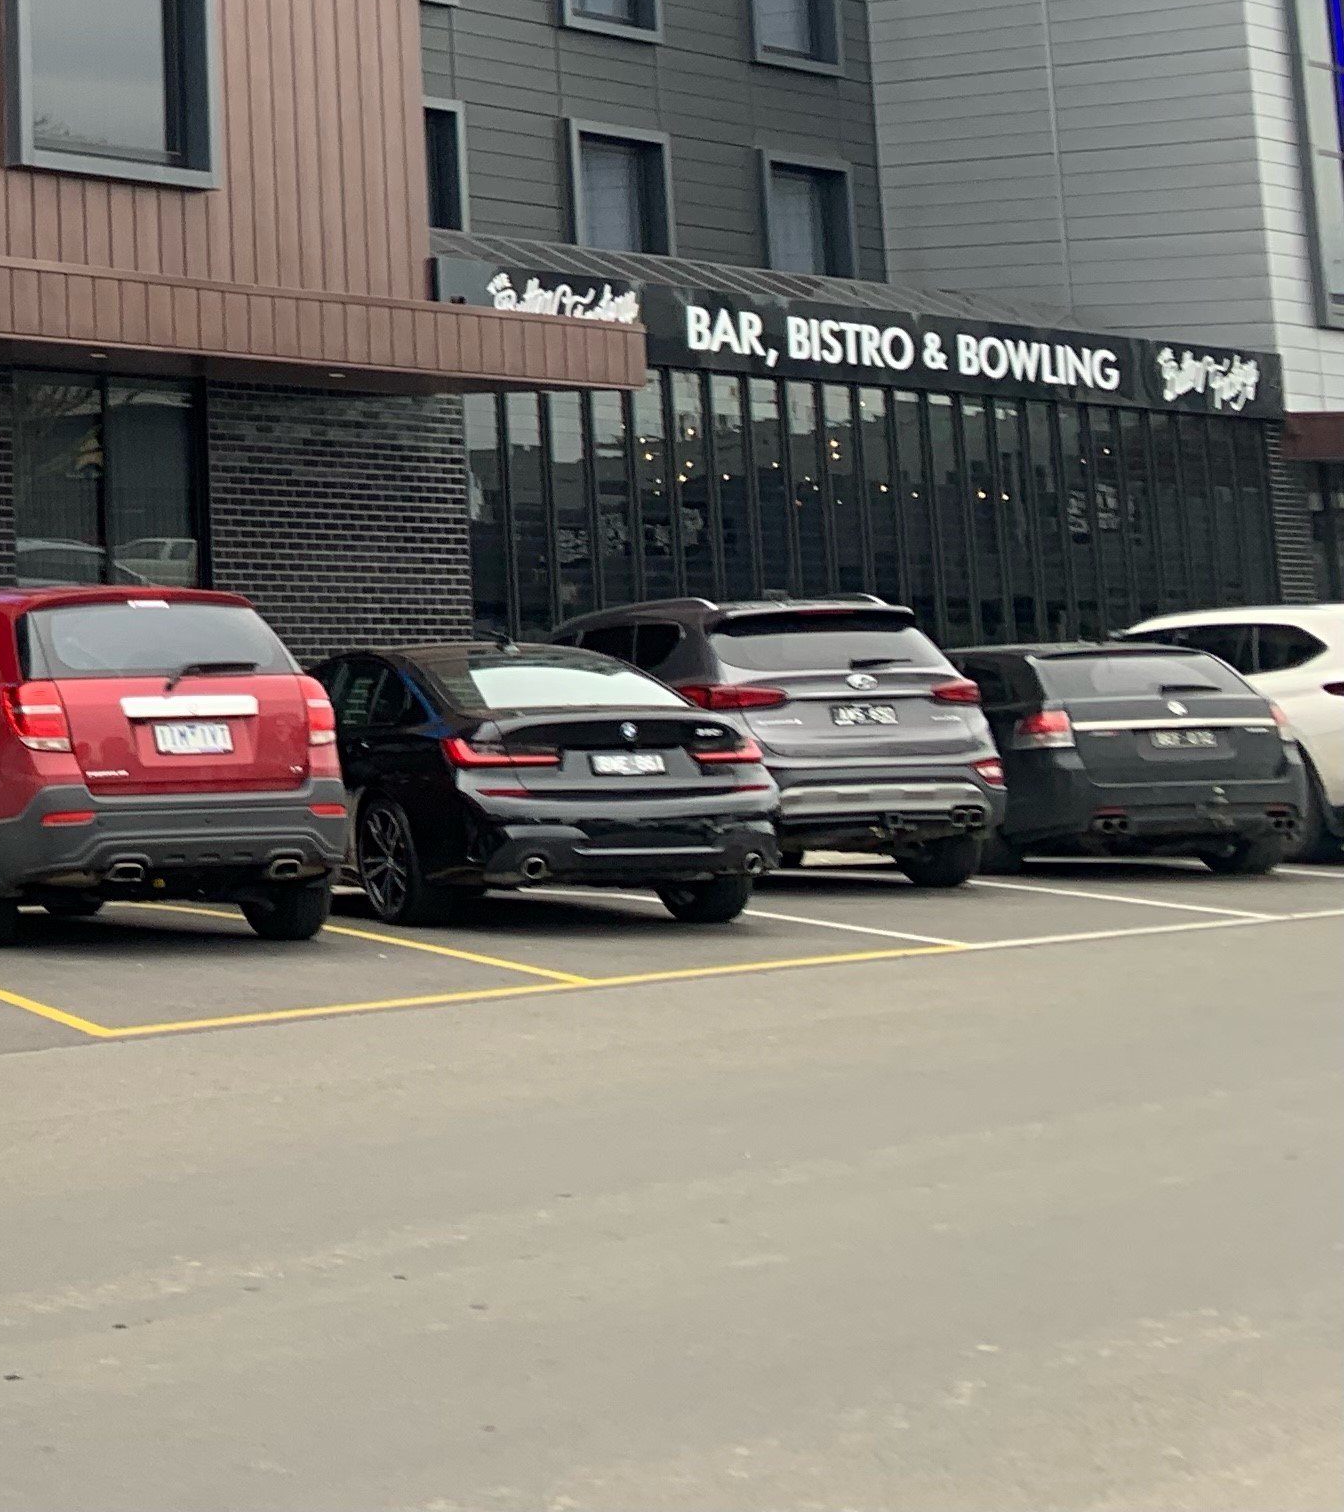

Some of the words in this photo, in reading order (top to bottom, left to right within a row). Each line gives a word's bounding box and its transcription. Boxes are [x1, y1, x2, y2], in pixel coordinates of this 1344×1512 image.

[686, 305, 779, 368] BAR,
[787, 316, 914, 371] BISTRO
[923, 332, 949, 371] &
[957, 334, 1121, 391] BOWLING
